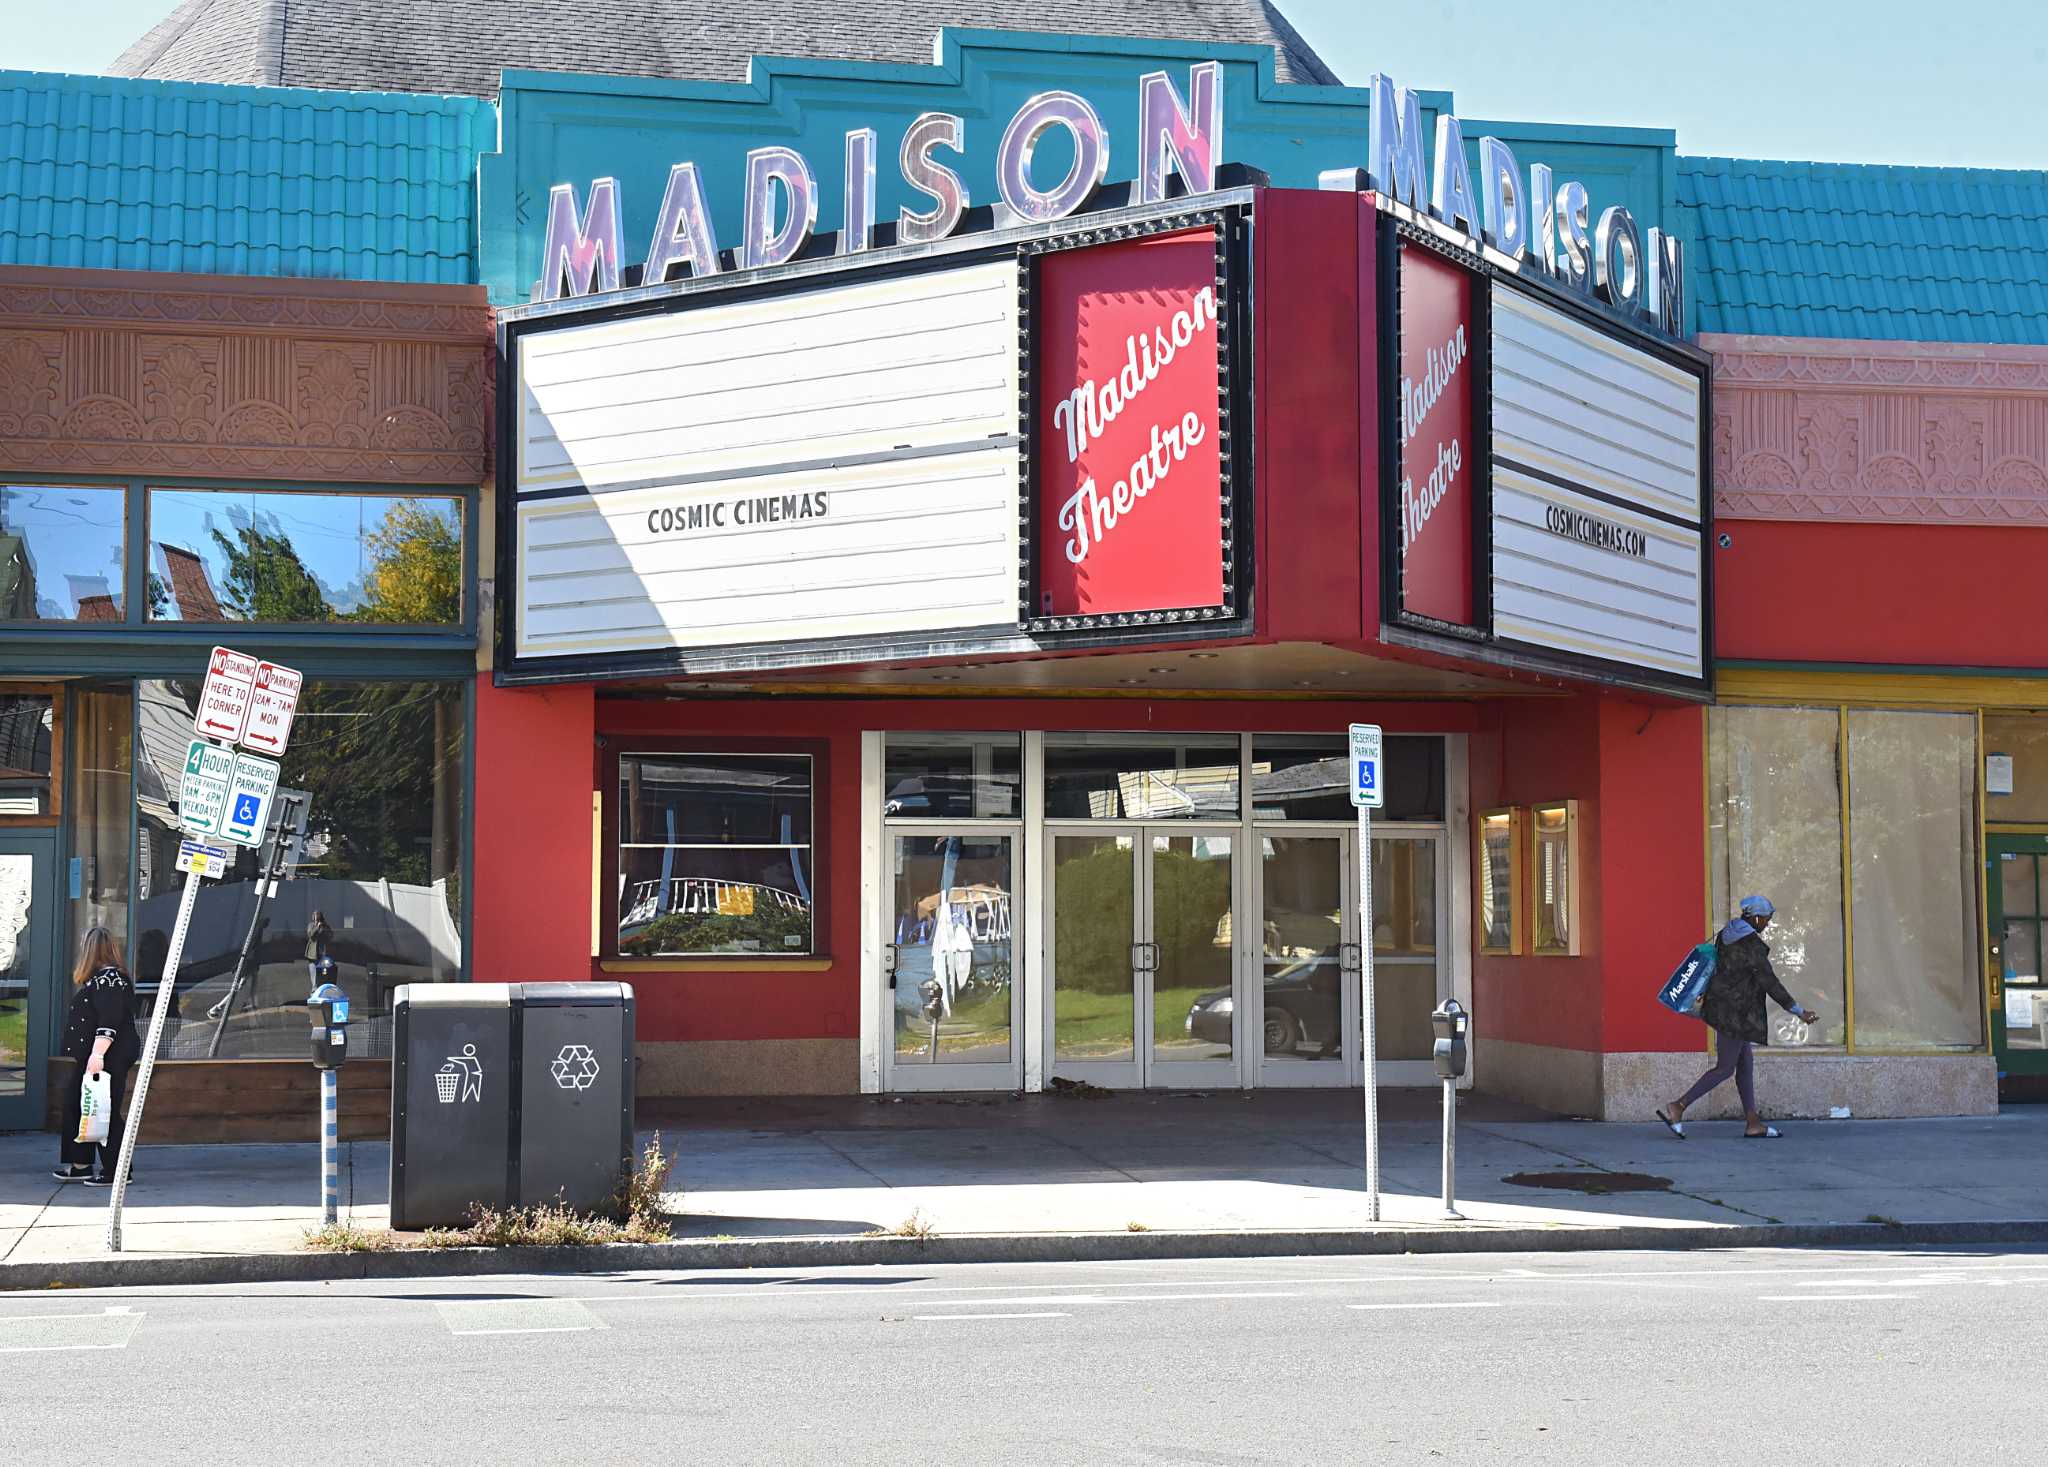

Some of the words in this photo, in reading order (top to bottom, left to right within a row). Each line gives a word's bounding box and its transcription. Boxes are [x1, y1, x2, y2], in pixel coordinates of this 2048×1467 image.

[541, 61, 1224, 300] MADISON
[1368, 72, 1685, 338] MADISON
[1054, 285, 1217, 463] Madison
[1059, 411, 1205, 563] Theatre
[647, 502, 725, 534] COSMIC
[734, 491, 828, 525] CINEMAS
[1546, 505, 1646, 558] COSMICCINEMAS.COM
[213, 653, 227, 672] NO
[225, 659, 255, 678] STANDING
[257, 667, 271, 686] NO
[270, 673, 299, 691] PARKING
[210, 681, 233, 699] HERE
[236, 686, 246, 700] TO
[207, 697, 242, 717] CORNER
[253, 693, 271, 707] 12AM
[278, 699, 293, 713] 7AM
[260, 711, 279, 726] MON
[1352, 732, 1379, 745] RESERVED
[190, 748, 202, 770] 4
[202, 753, 231, 775] HOUR
[1355, 746, 1378, 758] PARKING
[237, 761, 275, 781] RESERVED
[184, 785, 199, 799] 8AM
[206, 791, 222, 805] 6PM
[203, 779, 226, 793] PARKING
[236, 777, 269, 795] PARKING
[183, 799, 219, 818] WEEKDAYS
[1669, 960, 1699, 1002] Marshalls
